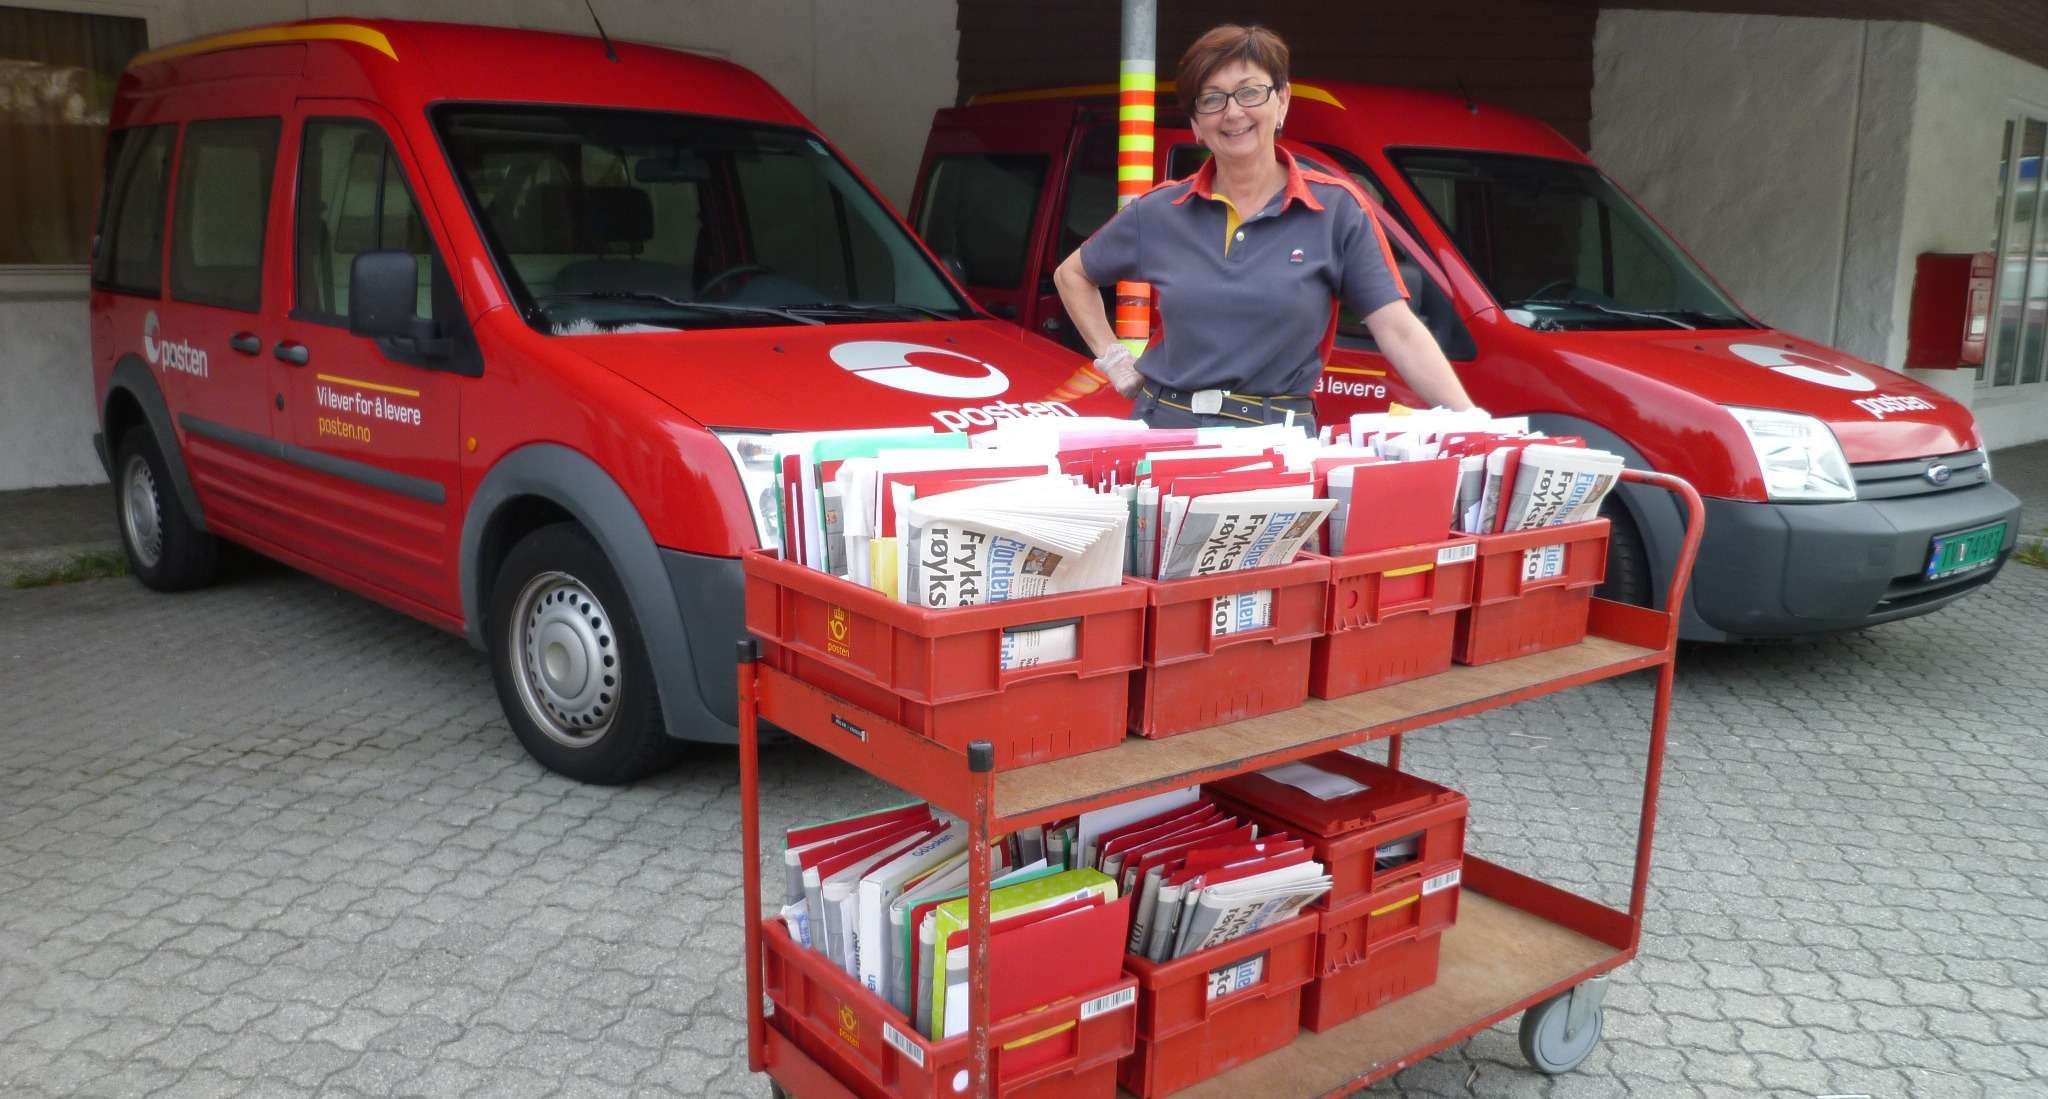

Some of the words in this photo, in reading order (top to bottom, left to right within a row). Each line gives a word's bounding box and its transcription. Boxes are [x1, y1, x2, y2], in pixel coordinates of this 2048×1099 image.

[161, 338, 208, 378] posten
[1327, 376, 1386, 398] levere
[317, 386, 327, 406] Vi
[328, 387, 354, 411] lever
[355, 392, 374, 416] for
[375, 396, 383, 418] å
[384, 398, 421, 425] levere
[930, 401, 1079, 433] posten
[1851, 394, 1937, 419] posten
[319, 416, 370, 443] posten.no
[1220, 514, 1267, 570] Frykta
[922, 528, 954, 606] røyks
[828, 642, 850, 658] posten
